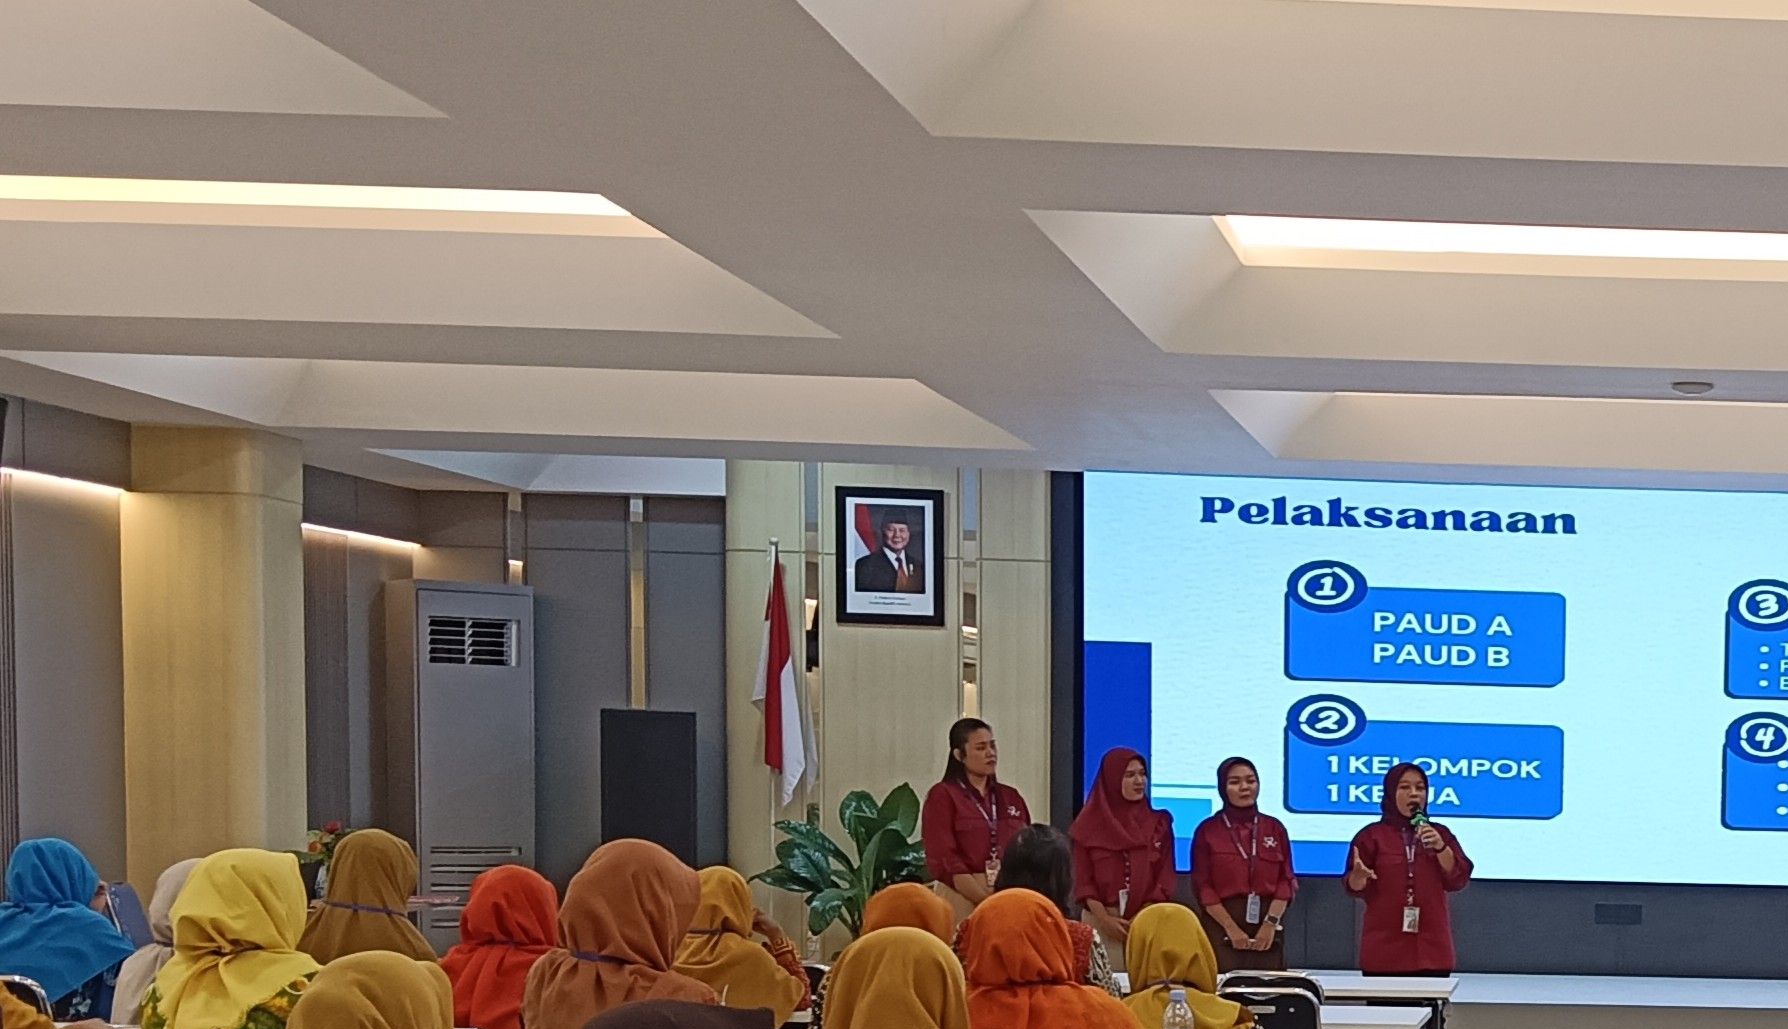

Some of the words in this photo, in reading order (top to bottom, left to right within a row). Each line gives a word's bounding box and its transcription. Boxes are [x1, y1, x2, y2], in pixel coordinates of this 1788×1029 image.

[1200, 496, 1578, 535] Pelaksanaan
[1316, 575, 1336, 597] 1
[1756, 592, 1779, 617] 3
[1373, 611, 1477, 635] PAUD
[1487, 615, 1513, 637] A
[1373, 643, 1476, 667] PAUD
[1486, 646, 1510, 667] B
[1315, 709, 1339, 731] 2
[1754, 726, 1777, 749] 4
[1327, 755, 1339, 773] 1
[1349, 756, 1541, 779] KEOMPOK
[1327, 784, 1339, 802] 1
